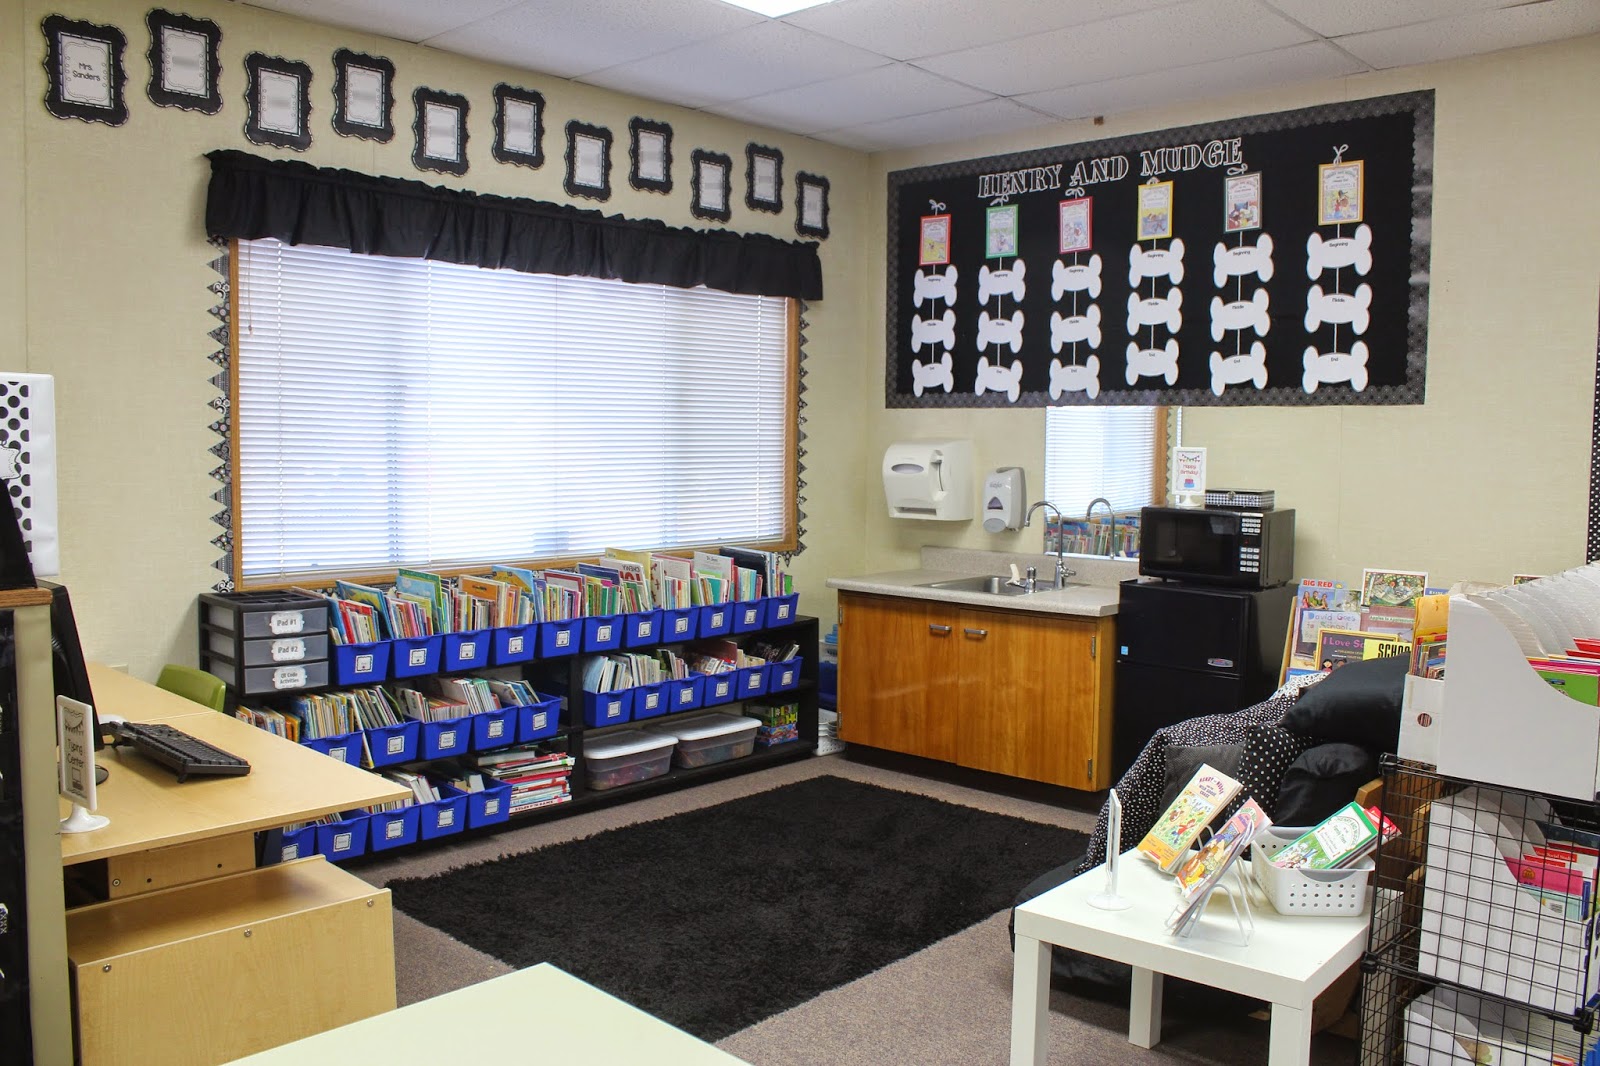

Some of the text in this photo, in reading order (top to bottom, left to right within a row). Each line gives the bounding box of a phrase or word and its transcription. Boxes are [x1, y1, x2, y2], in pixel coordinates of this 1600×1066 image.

[79, 62, 92, 70] Mrs.
[72, 70, 100, 81] Sanders
[978, 137, 1242, 198] HENRY AND MUDGE
[1308, 612, 1356, 622] David Goes
[1323, 636, 1327, 645] I
[1329, 637, 1350, 647] Love
[68, 738, 82, 755] Typing
[67, 753, 84, 767] Center
